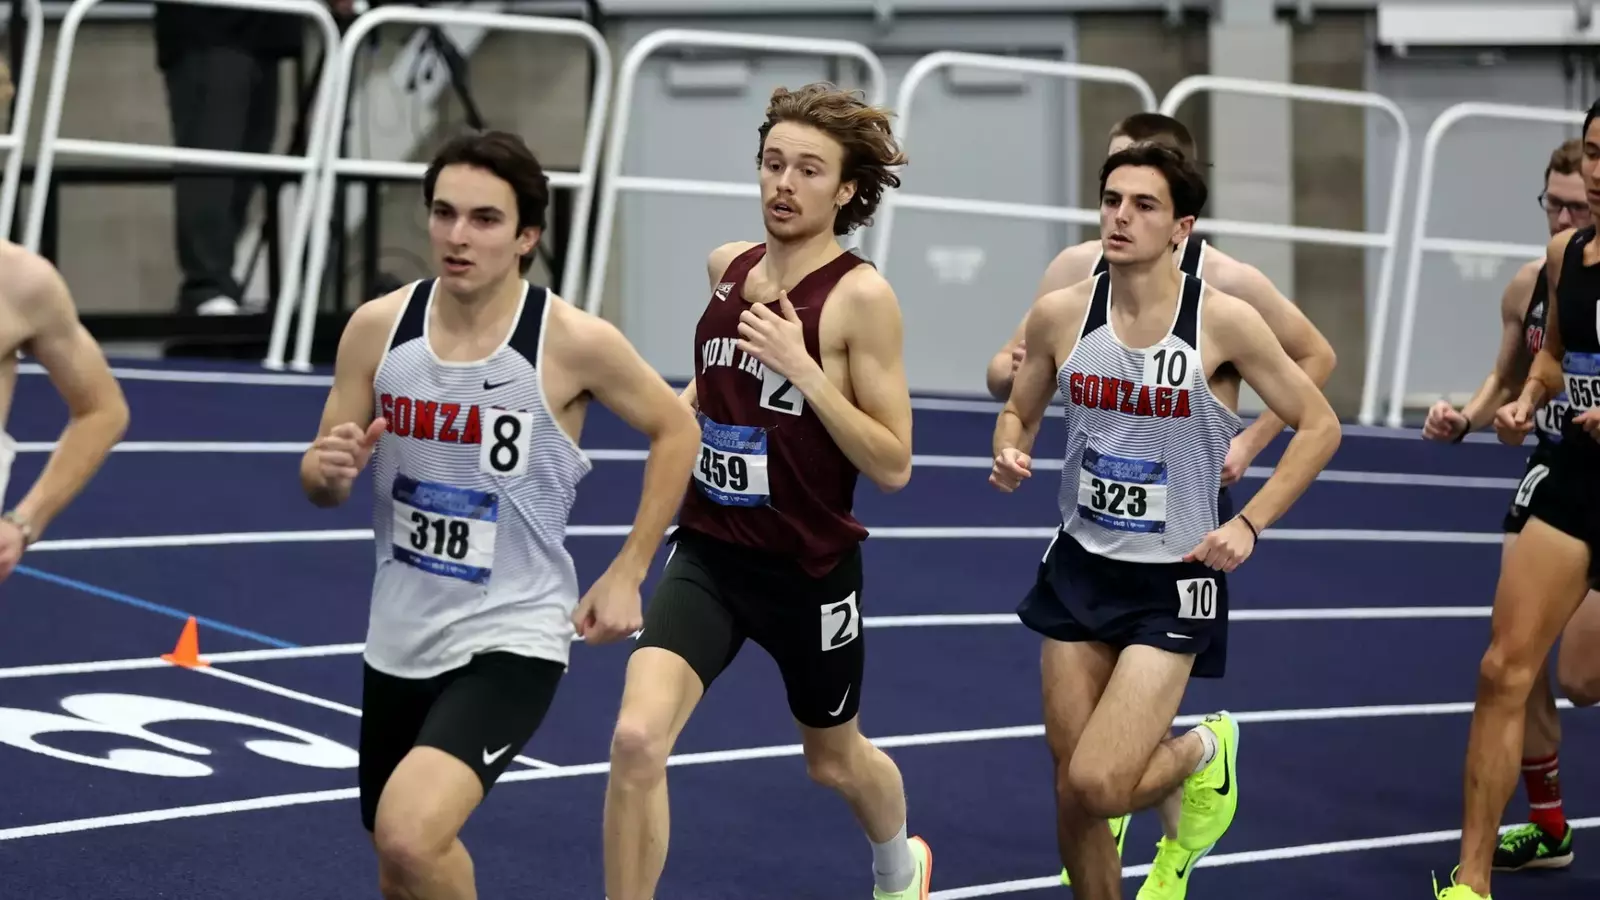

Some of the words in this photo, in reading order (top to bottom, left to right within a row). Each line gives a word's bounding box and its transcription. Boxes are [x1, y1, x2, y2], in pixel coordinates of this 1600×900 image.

[701, 337, 764, 380] MONA
[1153, 349, 1187, 386] 10
[1069, 372, 1191, 418] GONZAGA
[381, 394, 527, 444] GONZA
[490, 414, 521, 472] 8
[700, 446, 748, 491] 459
[1521, 468, 1548, 501] 4
[1091, 478, 1147, 516] 323
[410, 511, 469, 560] 318
[1187, 580, 1212, 617] 10
[830, 602, 852, 647] 2
